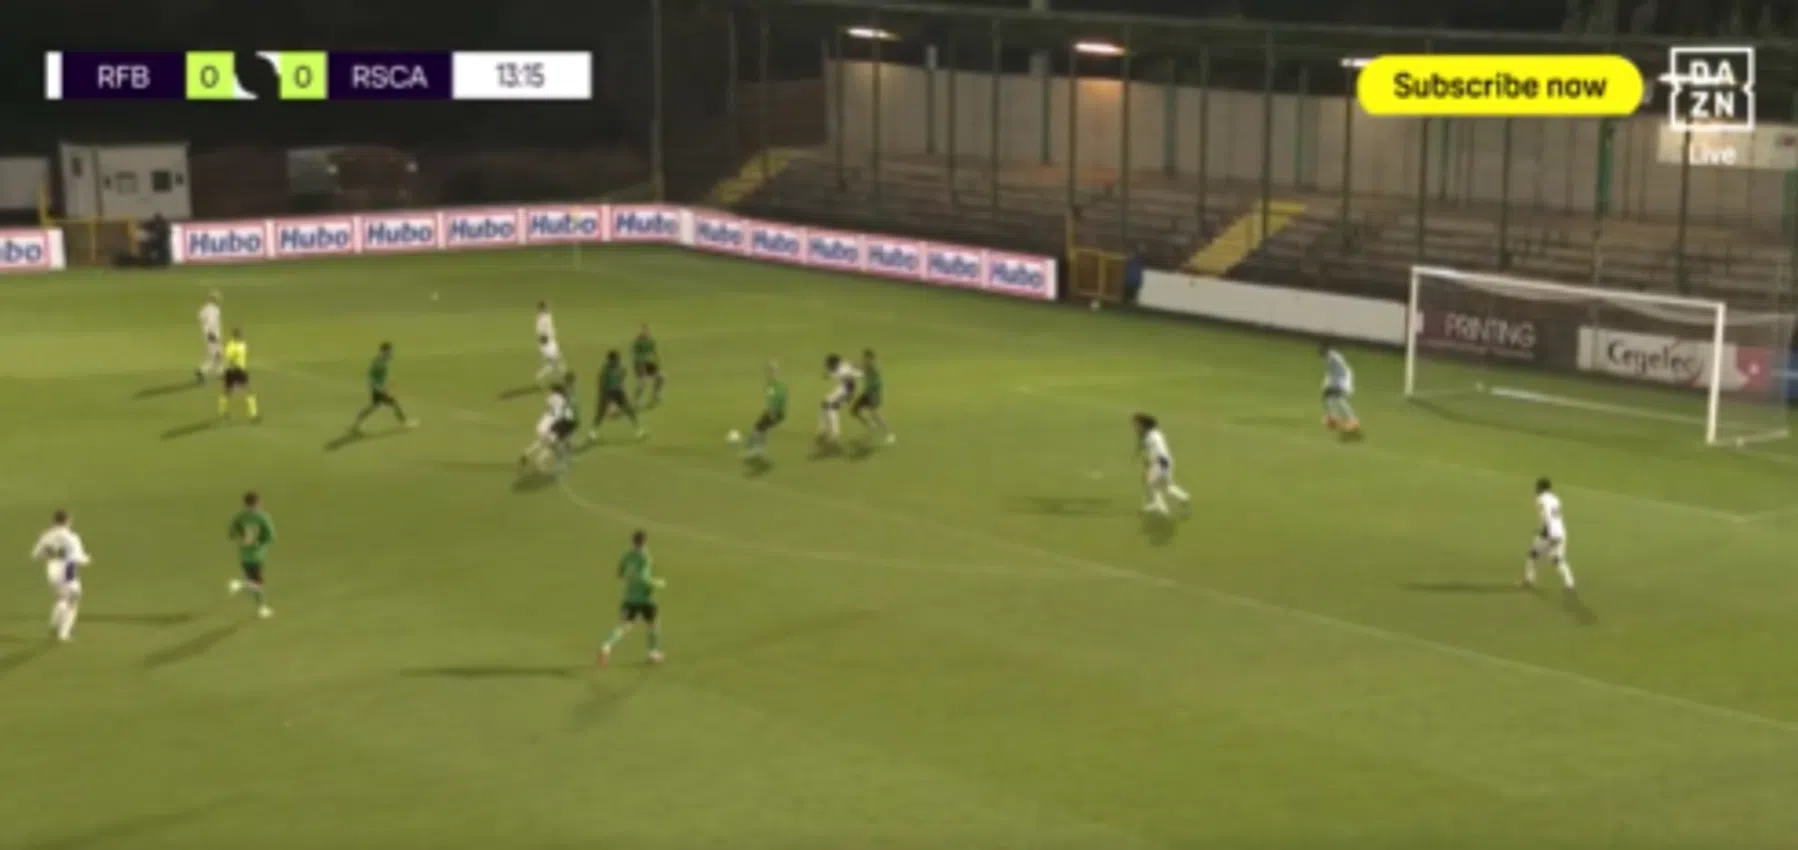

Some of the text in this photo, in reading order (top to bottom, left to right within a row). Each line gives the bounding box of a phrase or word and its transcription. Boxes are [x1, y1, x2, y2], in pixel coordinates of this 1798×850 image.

[367, 219, 432, 244] Hubo
[451, 212, 515, 239] Hubo
[616, 206, 676, 234] Hubo
[697, 219, 742, 246] Hubo
[189, 231, 261, 254] Hubo
[279, 224, 349, 249] Hubo
[752, 227, 799, 254] Hubo
[808, 236, 858, 264] Hubo
[868, 243, 920, 272] Hubo
[928, 251, 980, 280] Hubo
[990, 259, 1044, 290] Hubo
[1445, 314, 1535, 348] PRINTING
[1607, 340, 1696, 375] Cegelec
